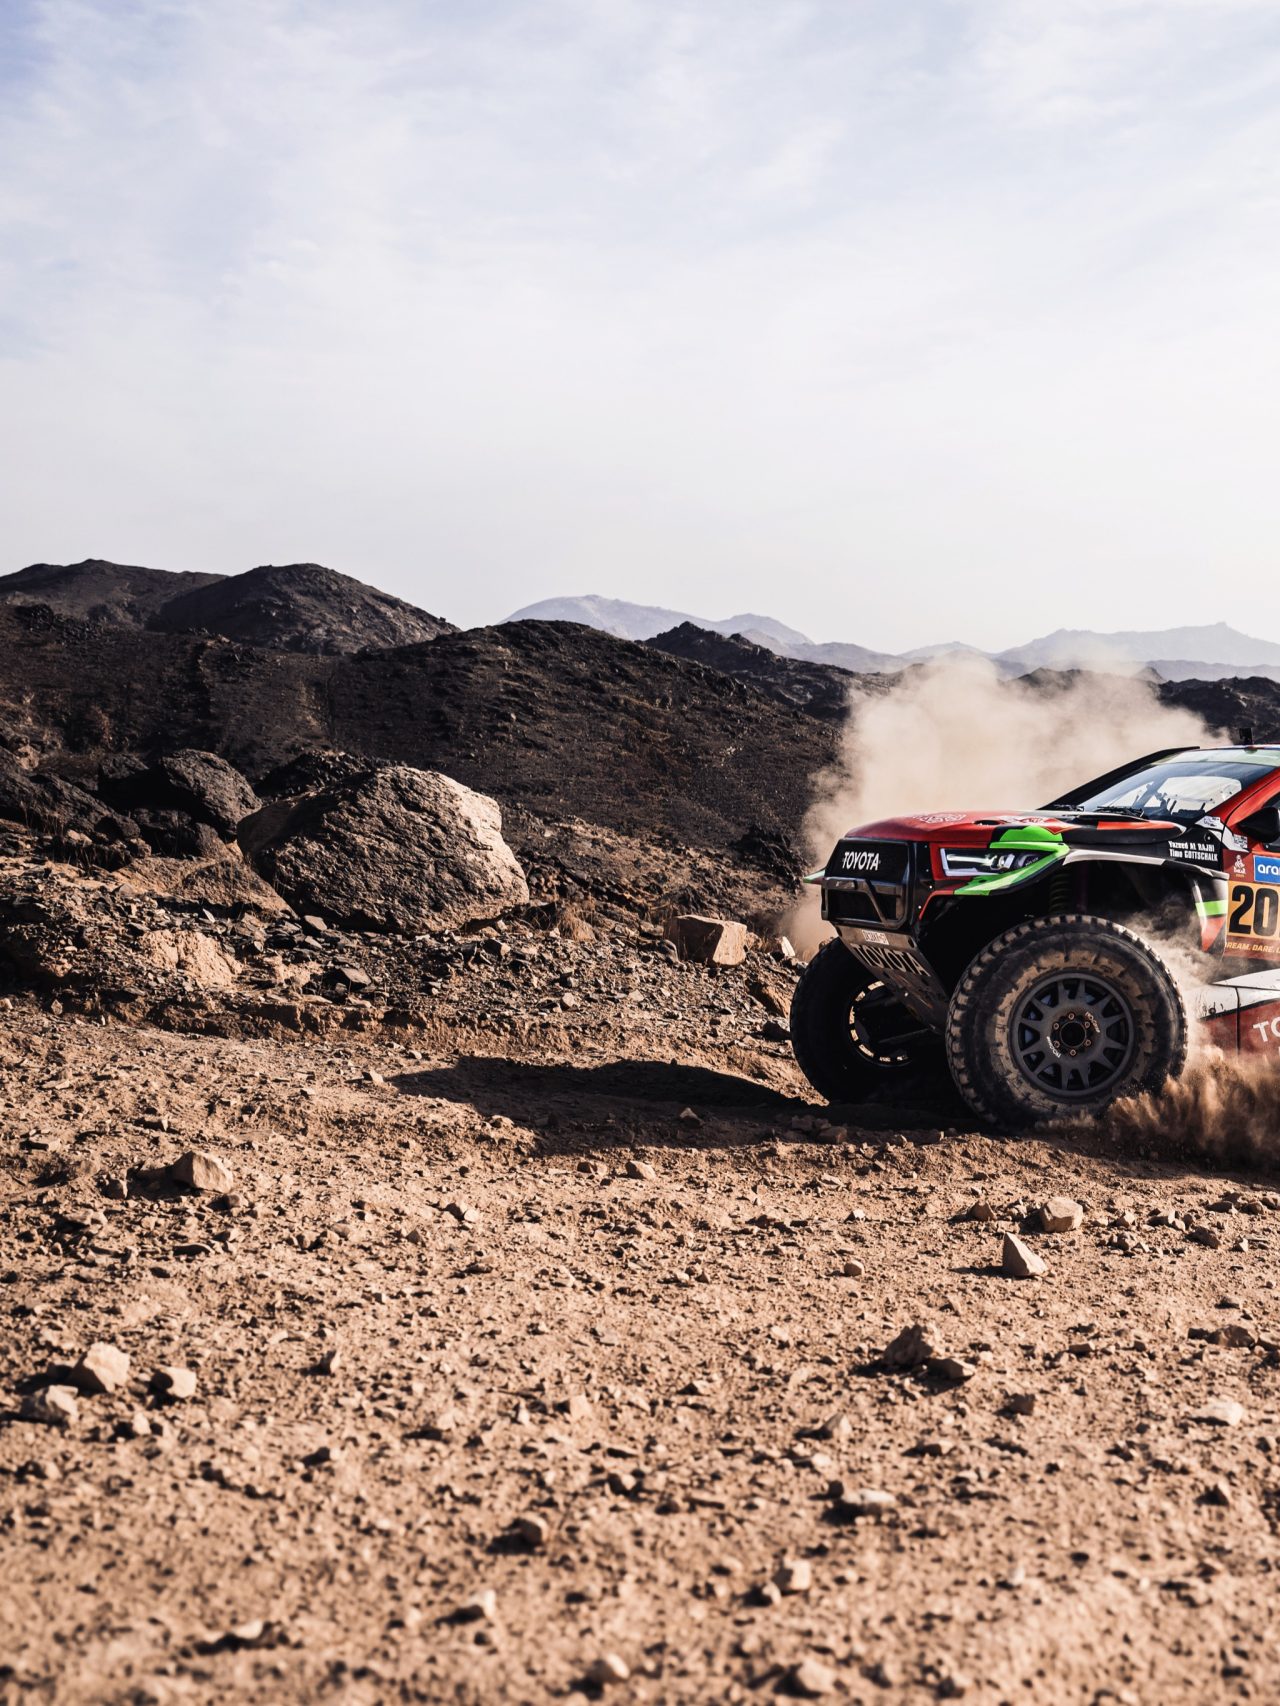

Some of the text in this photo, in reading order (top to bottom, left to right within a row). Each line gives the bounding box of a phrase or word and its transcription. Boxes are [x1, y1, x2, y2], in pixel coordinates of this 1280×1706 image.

[842, 851, 880, 871] TOYOTA
[1184, 850, 1218, 862] GOTTSCHALK
[1252, 944, 1275, 953] DARE.
[850, 942, 932, 977] TOYOTA
